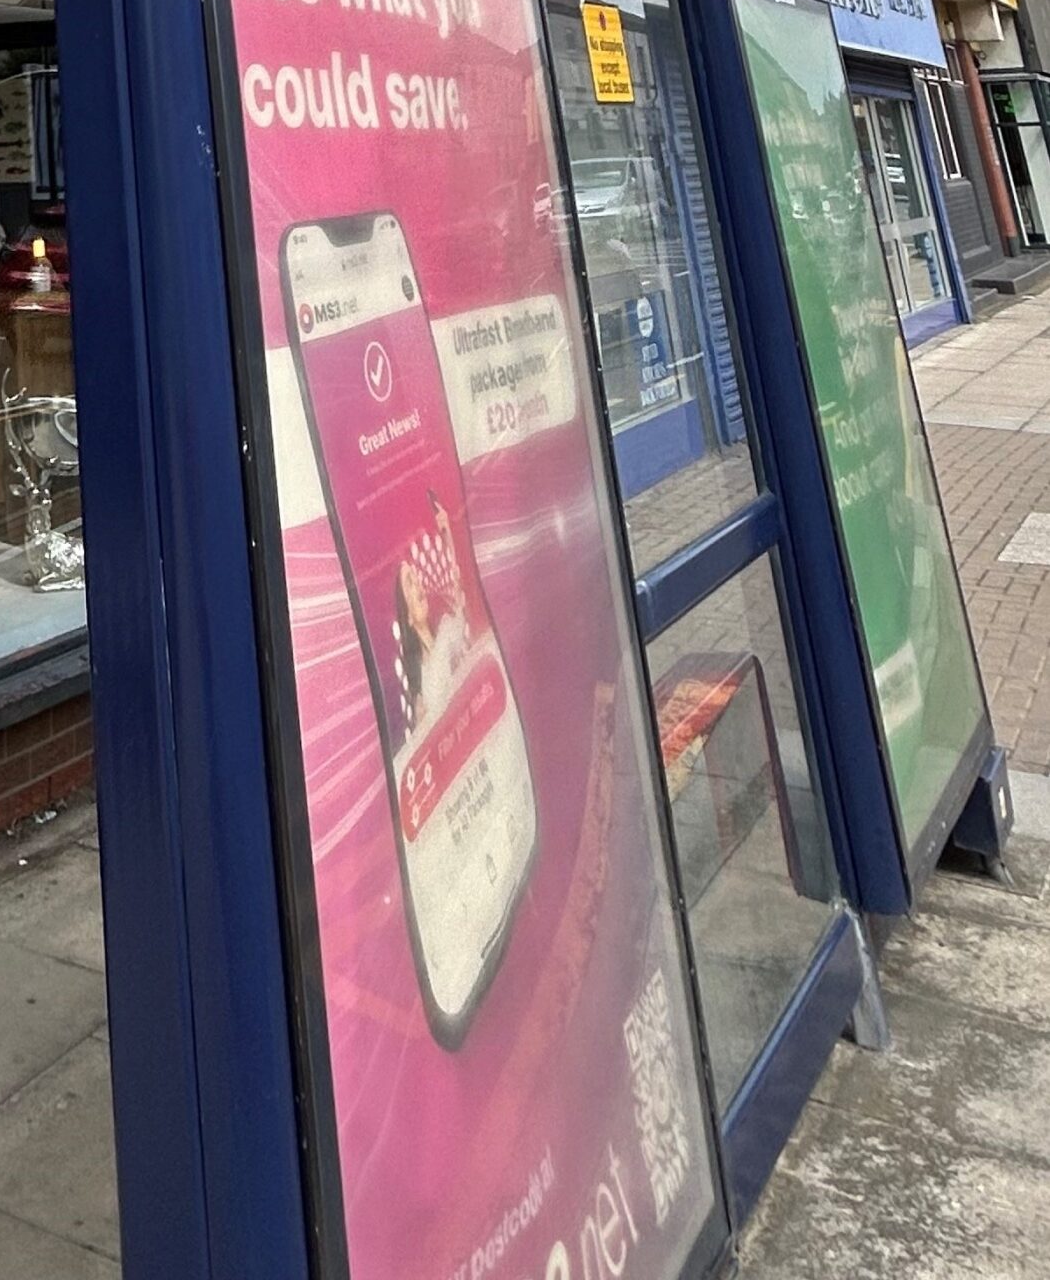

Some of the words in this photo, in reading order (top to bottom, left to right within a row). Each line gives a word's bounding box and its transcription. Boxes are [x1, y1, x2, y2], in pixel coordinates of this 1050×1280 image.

[243, 51, 380, 129] could
[385, 72, 469, 131] save.
[452, 321, 505, 356] Ultrafast
[359, 425, 390, 455] Great
